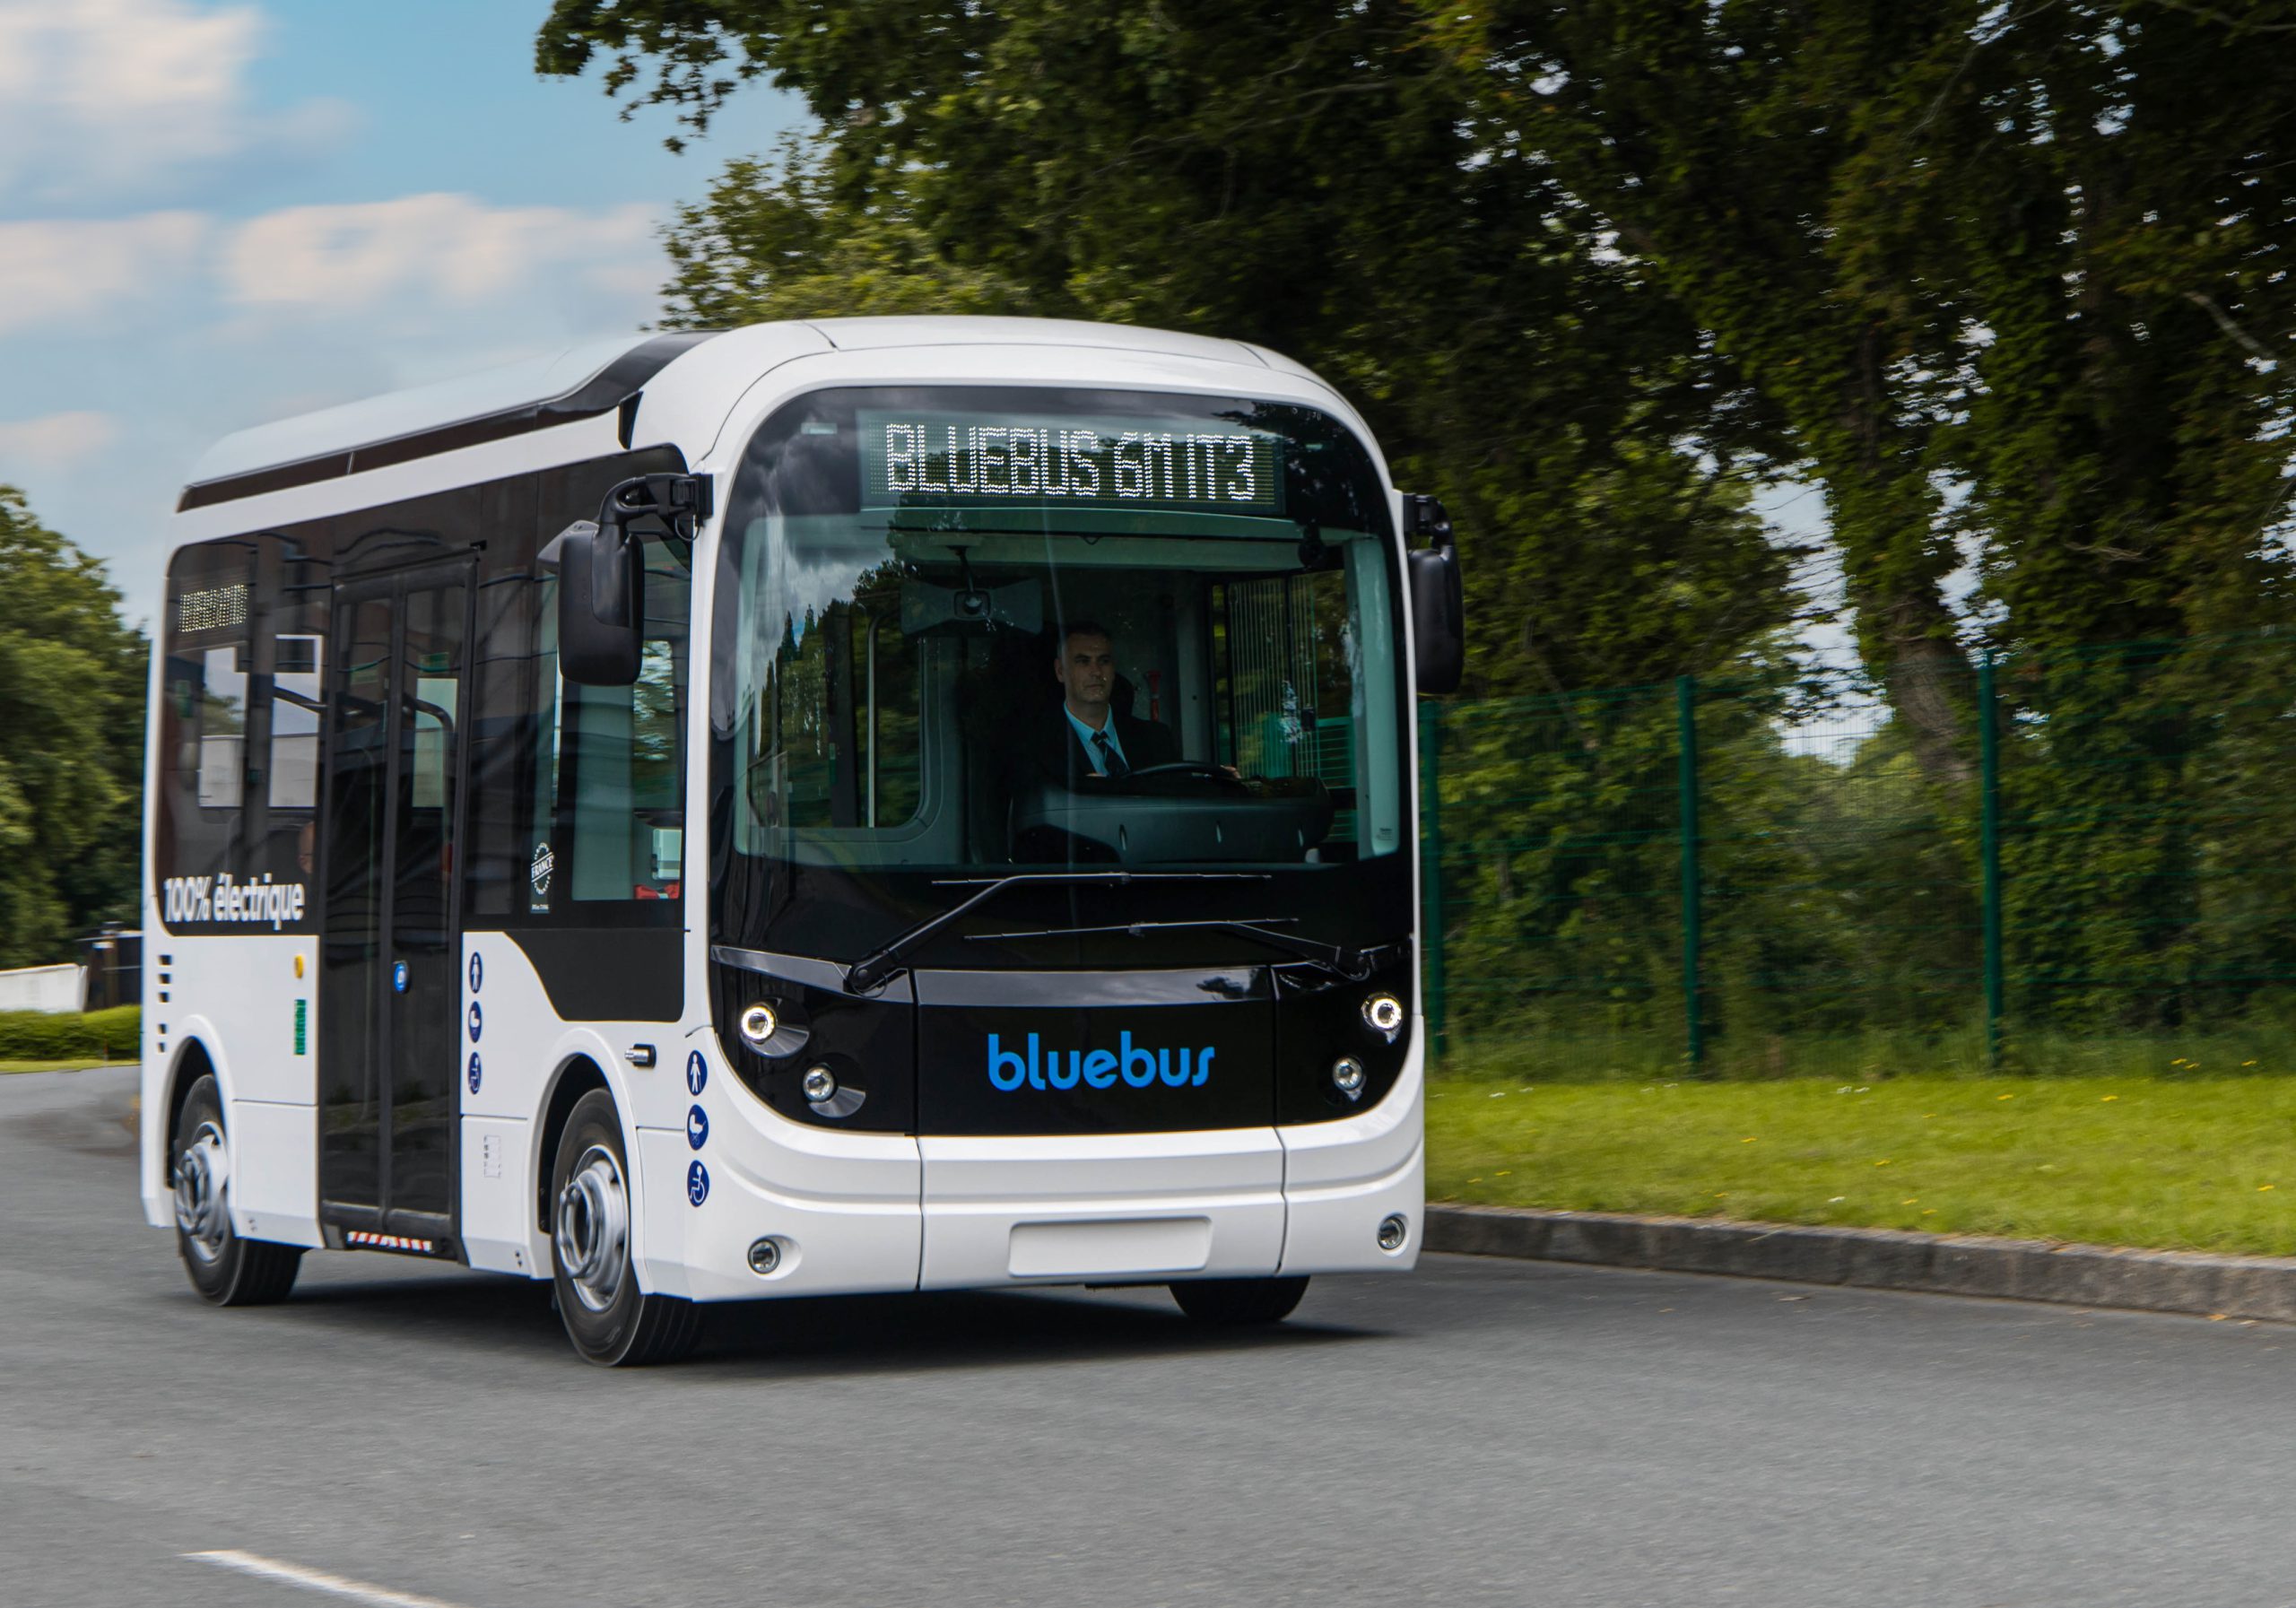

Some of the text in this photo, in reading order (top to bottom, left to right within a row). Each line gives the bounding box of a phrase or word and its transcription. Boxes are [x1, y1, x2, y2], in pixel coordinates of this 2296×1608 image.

[886, 423, 1100, 497] BLUEBUS
[531, 855, 553, 879] FRANCE
[163, 873, 305, 931] 100% électrique
[987, 1030, 1215, 1091] bluebus
